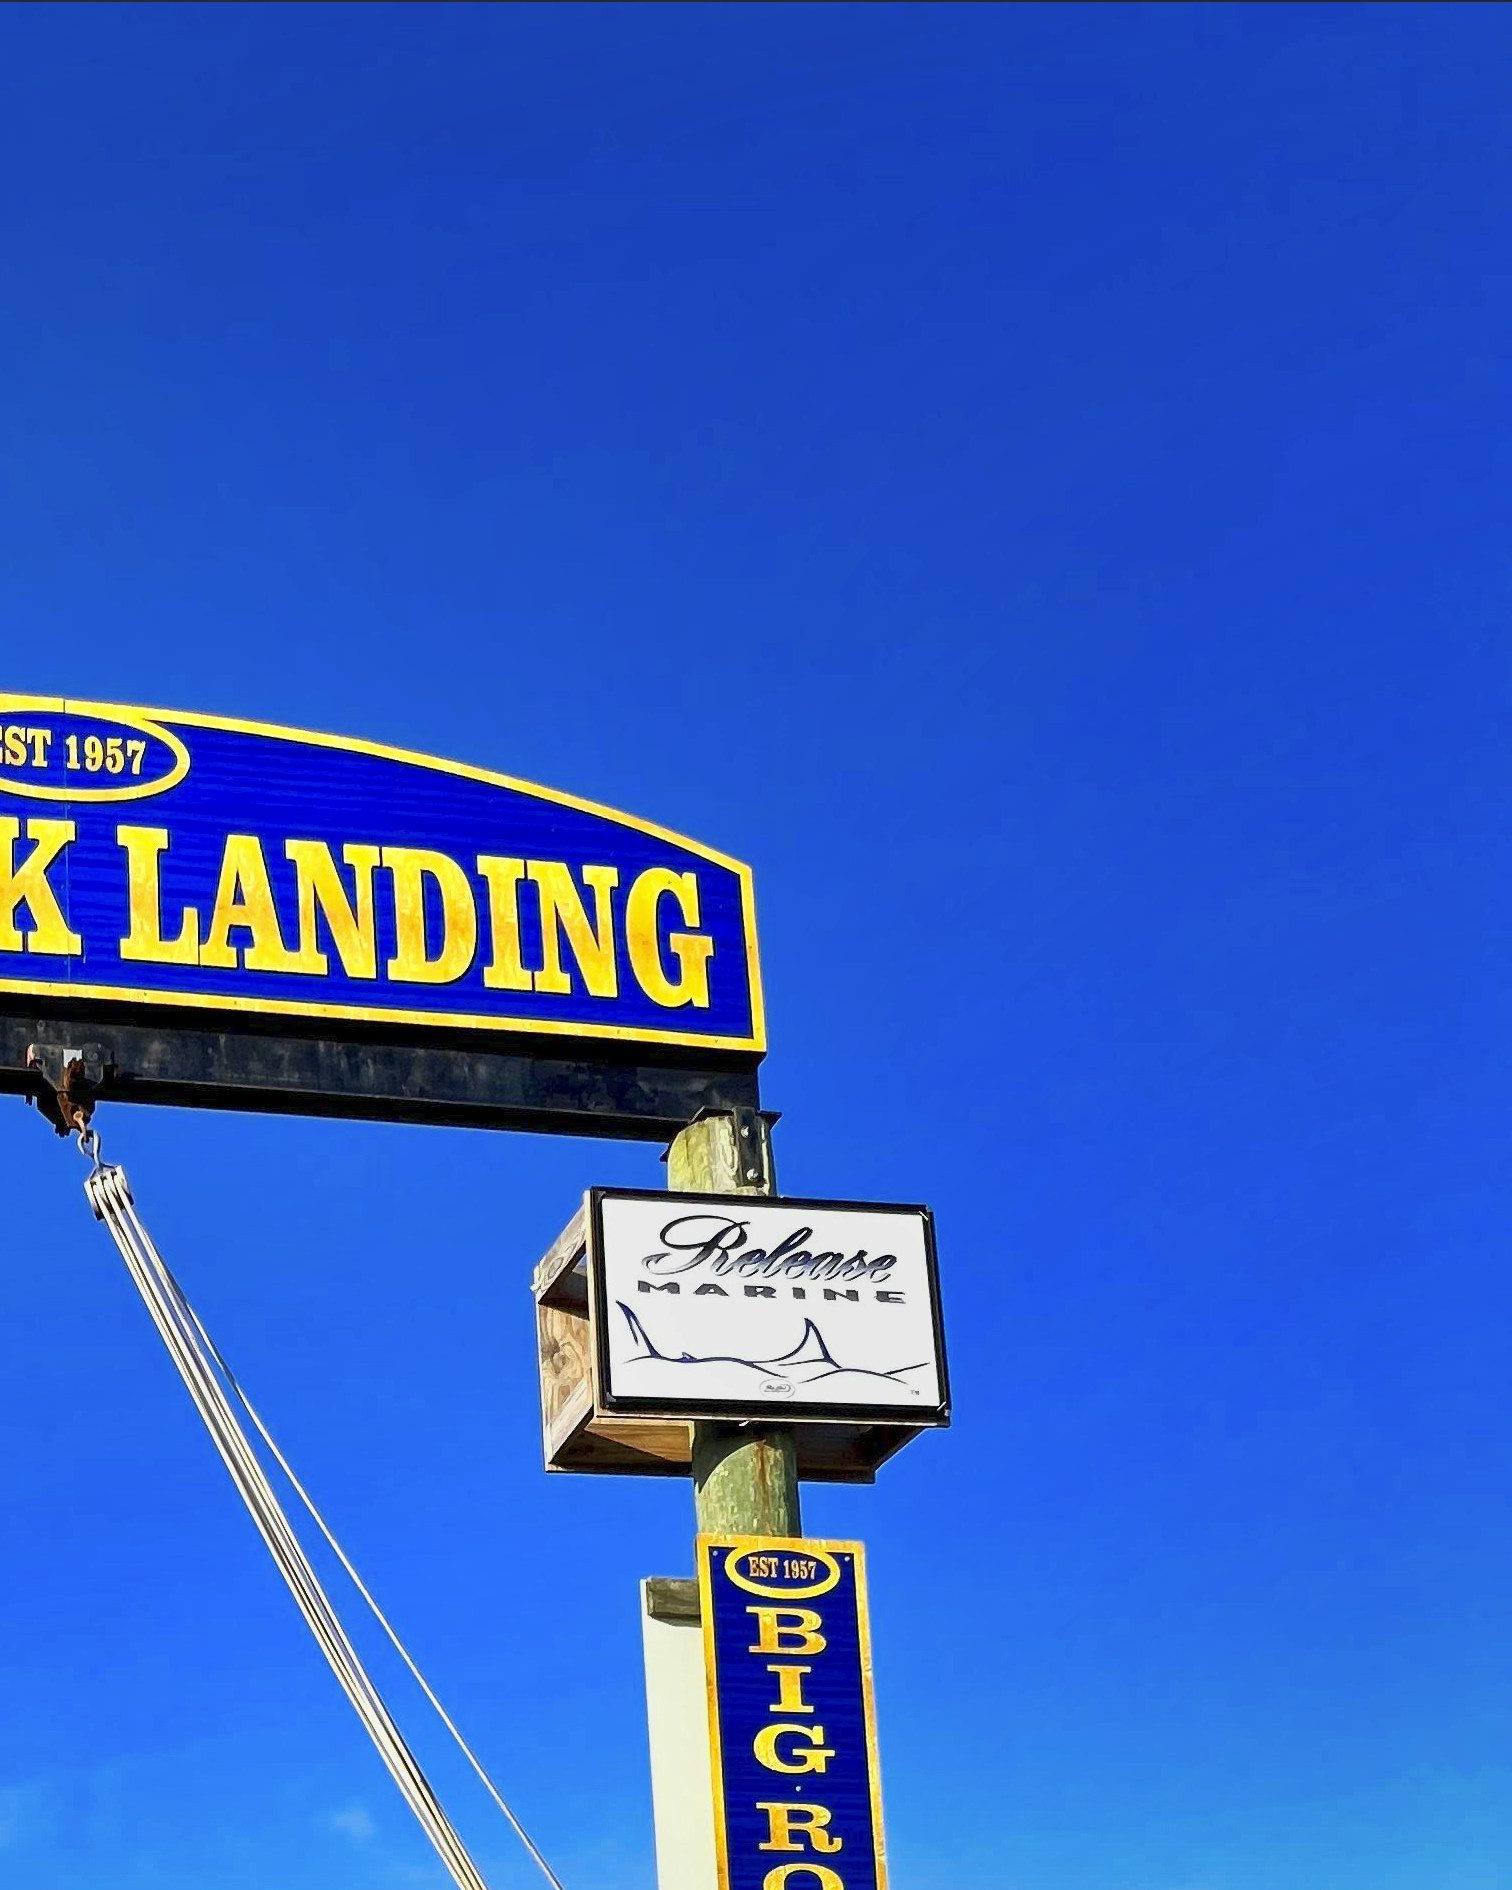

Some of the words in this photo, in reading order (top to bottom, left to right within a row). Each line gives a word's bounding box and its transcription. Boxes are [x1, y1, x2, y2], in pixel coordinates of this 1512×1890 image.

[65, 734, 145, 776] 1957
[116, 824, 714, 1008] LANDING
[642, 1214, 899, 1283] Release
[637, 1280, 906, 1304] MARINE
[748, 1556, 778, 1579] EST
[783, 1558, 817, 1580] 1957
[746, 1605, 835, 1774] BIG
